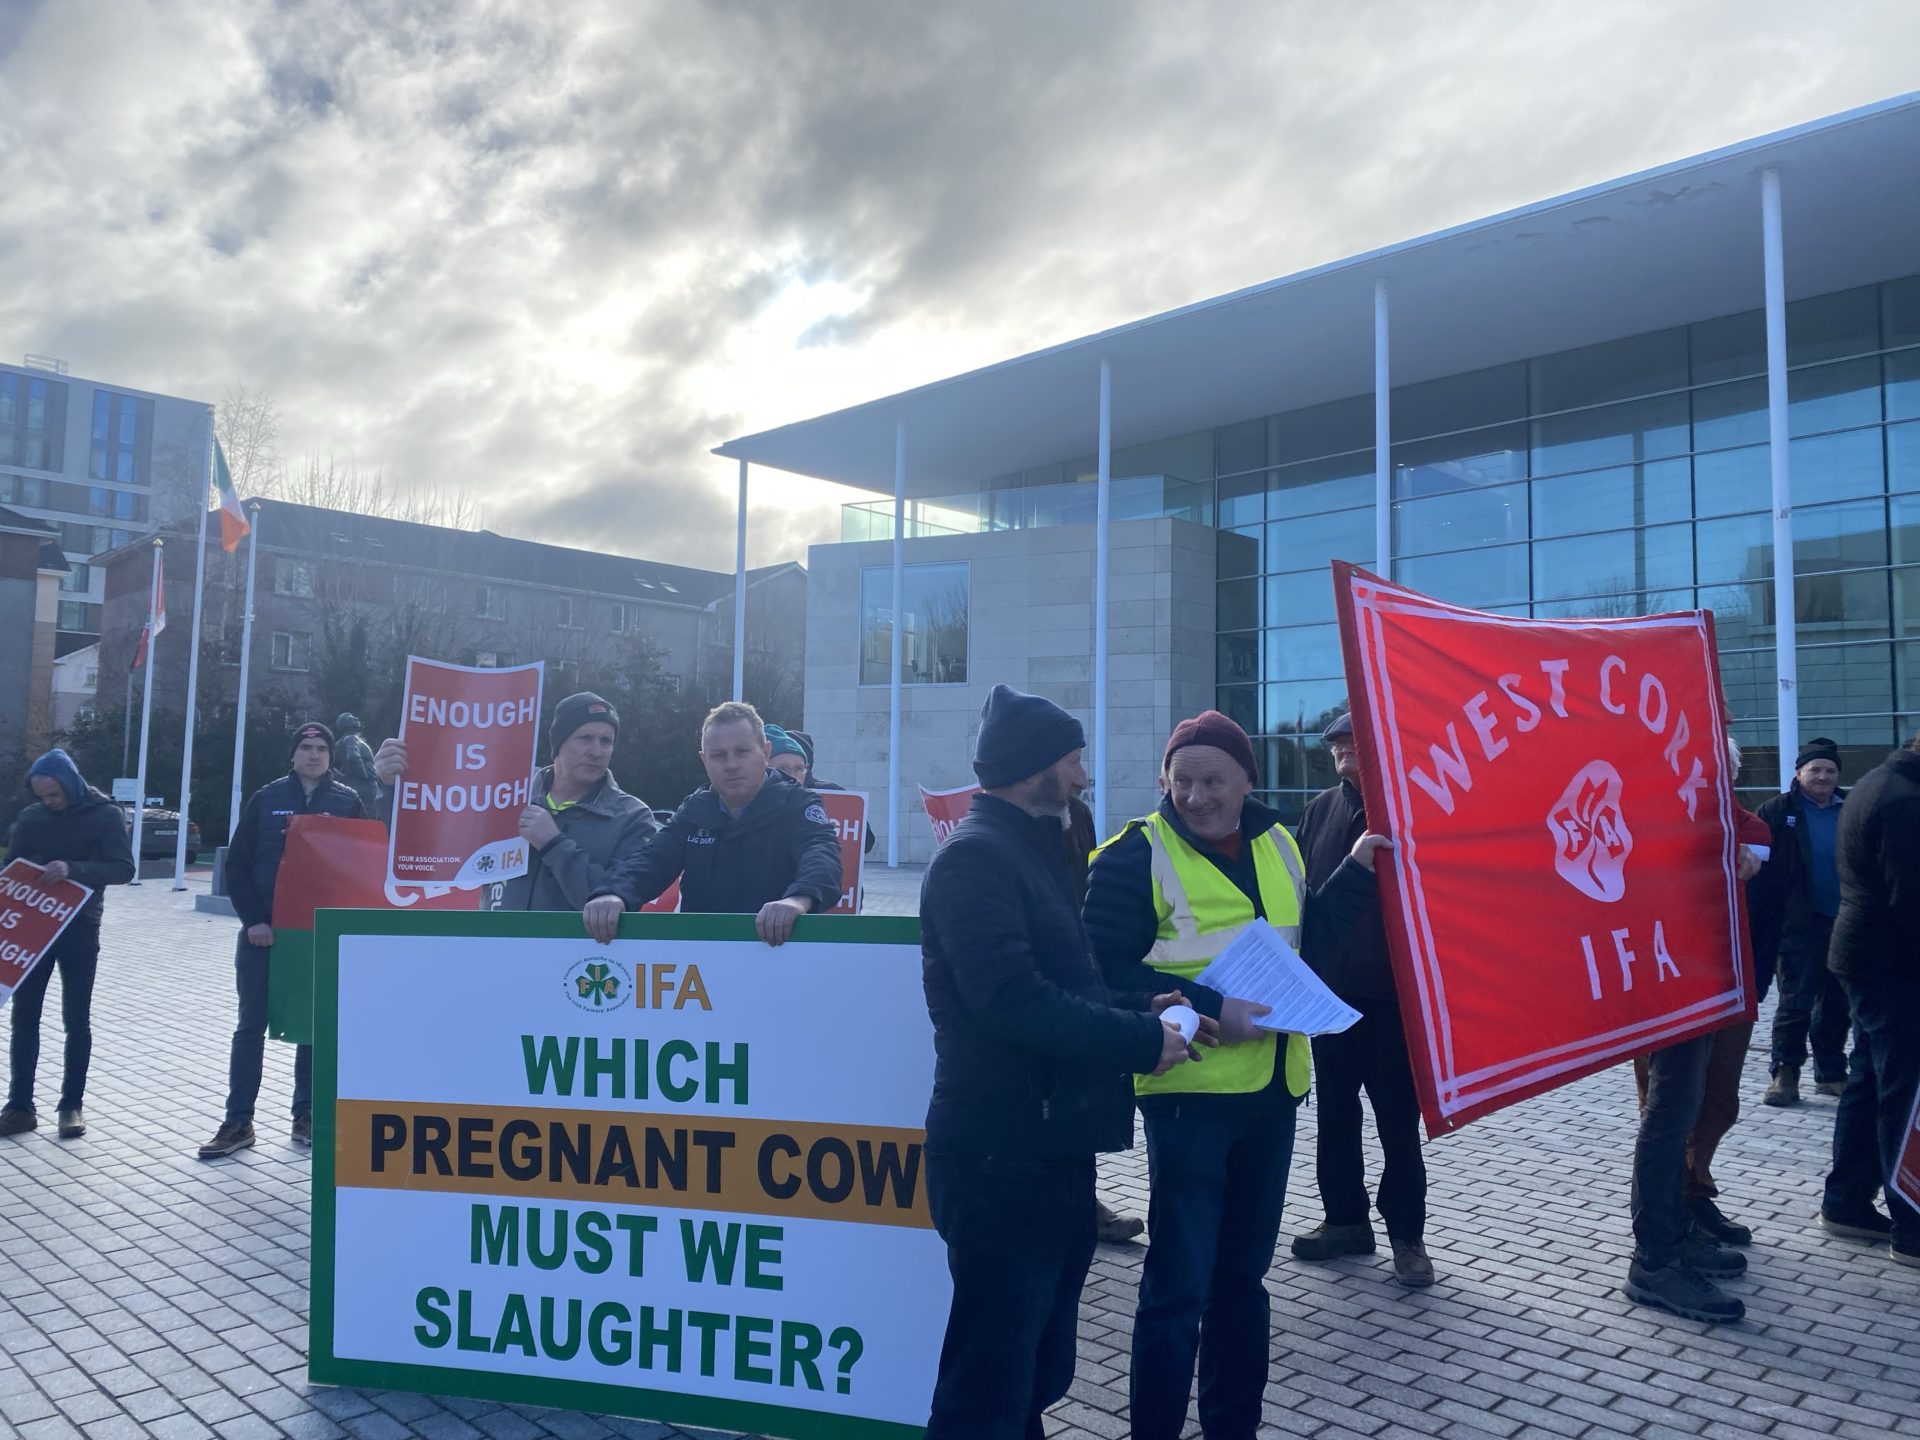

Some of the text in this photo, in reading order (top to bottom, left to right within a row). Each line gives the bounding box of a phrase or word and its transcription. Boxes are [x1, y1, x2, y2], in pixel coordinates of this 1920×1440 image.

[410, 694, 535, 728] ENOUGH
[1408, 654, 1708, 822] WEST CORK
[455, 743, 486, 770] IS
[401, 777, 529, 813] ENOUGH
[397, 863, 414, 871] YOUR
[501, 847, 523, 870] IFA
[635, 963, 713, 1011] IFA
[1581, 920, 1681, 1001] IFA
[520, 1034, 749, 1106] WHICH
[370, 1113, 922, 1210] PREGNANT COW
[470, 1204, 785, 1292] MUST WE
[413, 1286, 864, 1395] SLAUGHTER?
